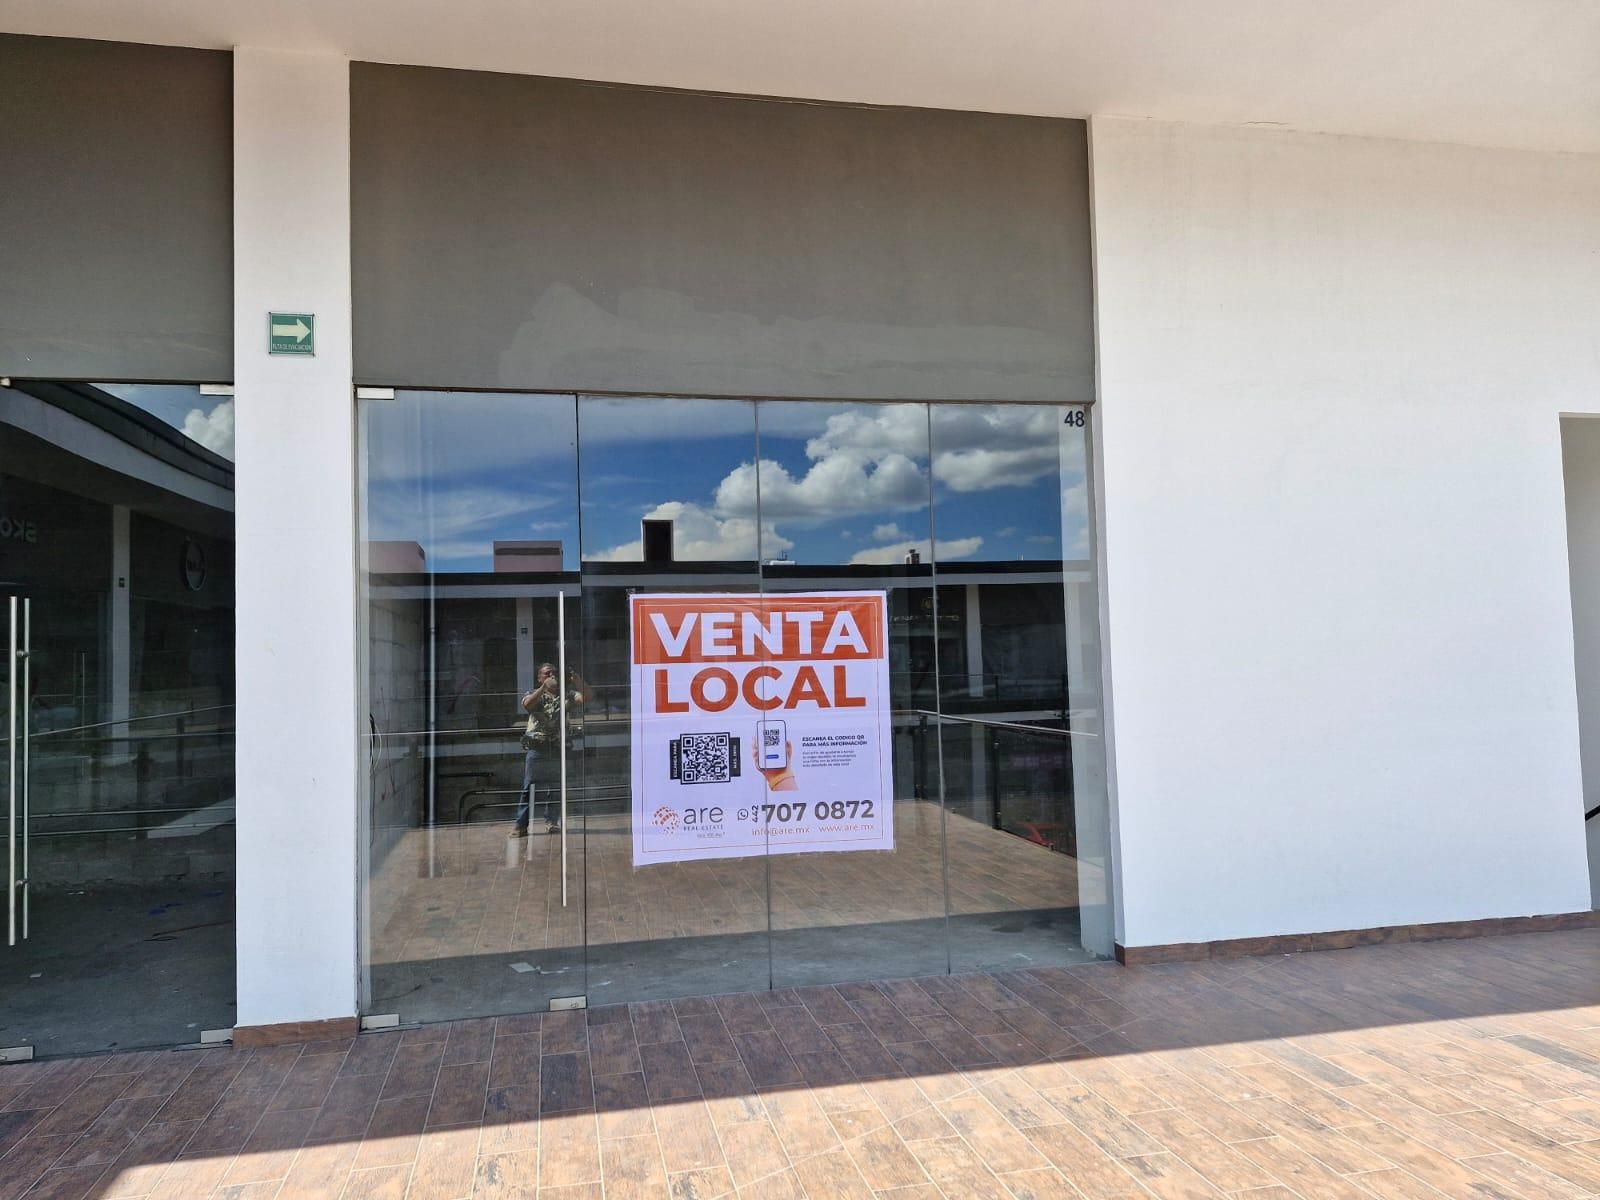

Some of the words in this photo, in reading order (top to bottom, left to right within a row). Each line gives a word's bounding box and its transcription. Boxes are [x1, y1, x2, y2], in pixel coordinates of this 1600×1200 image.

[1063, 410, 1085, 428] 48
[649, 610, 869, 657] VENTA
[654, 665, 866, 713] LOCAL
[683, 807, 724, 825] are
[751, 804, 759, 823] 442
[761, 802, 807, 823] 707
[814, 799, 875, 821] 0872
[751, 826, 810, 837] info@are.mx
[818, 823, 875, 833] www.are.mx
